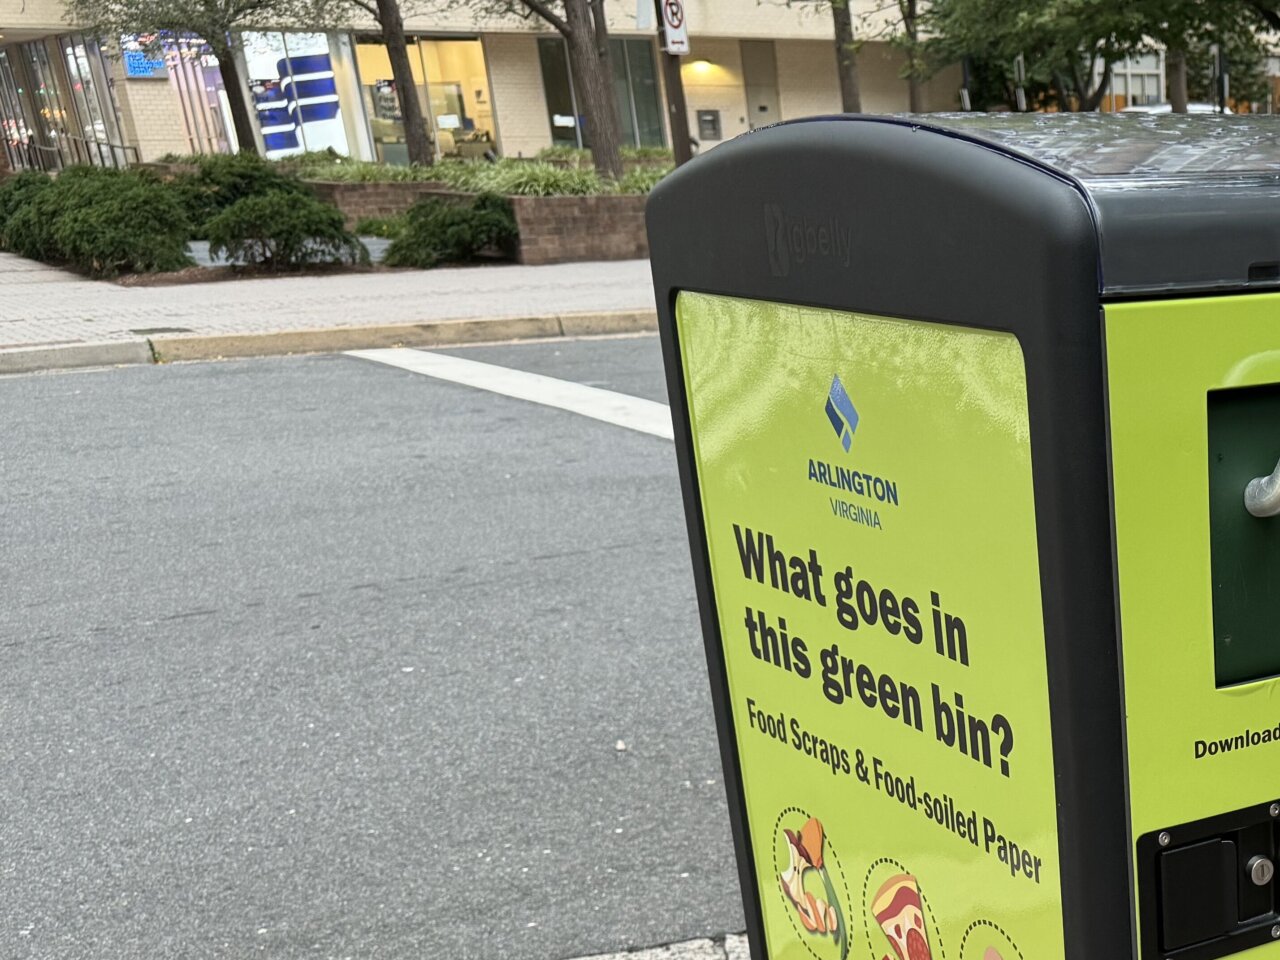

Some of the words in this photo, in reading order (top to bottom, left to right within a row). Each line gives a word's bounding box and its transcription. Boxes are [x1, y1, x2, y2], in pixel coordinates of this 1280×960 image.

[808, 458, 899, 506] ARLINGTON
[829, 497, 882, 530] VIRGINIA
[732, 523, 827, 607] What
[834, 565, 923, 645] goes
[930, 590, 969, 667] in
[744, 606, 811, 679] this
[820, 644, 924, 732] green
[931, 682, 1014, 778] bin?
[746, 697, 787, 744] Food
[791, 717, 851, 775] Scraps
[855, 749, 870, 785] &
[872, 756, 979, 847] Food-soiled
[983, 816, 1042, 884] Paper
